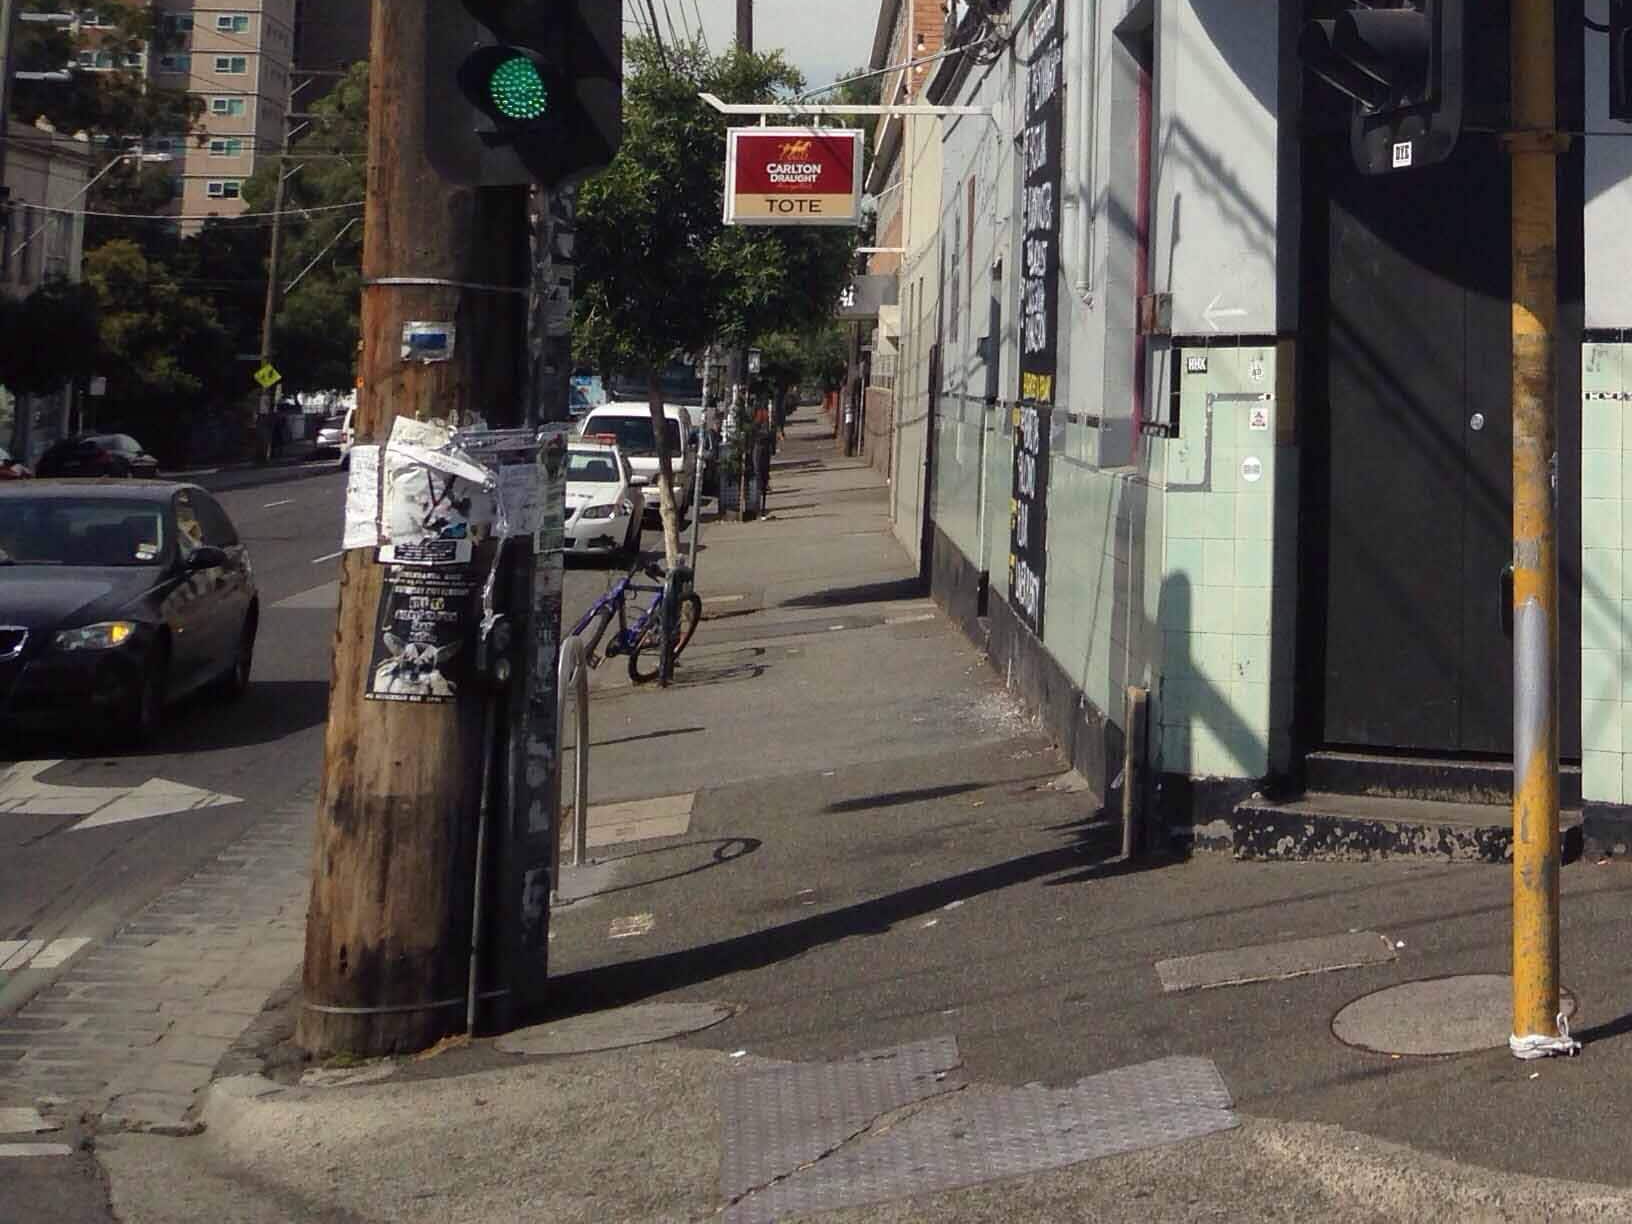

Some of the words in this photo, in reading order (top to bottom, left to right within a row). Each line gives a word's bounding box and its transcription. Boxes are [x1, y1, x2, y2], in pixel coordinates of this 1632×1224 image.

[766, 162, 822, 175] CARLTON
[769, 173, 819, 184] DRAUGHT
[765, 199, 823, 213] TOTE
